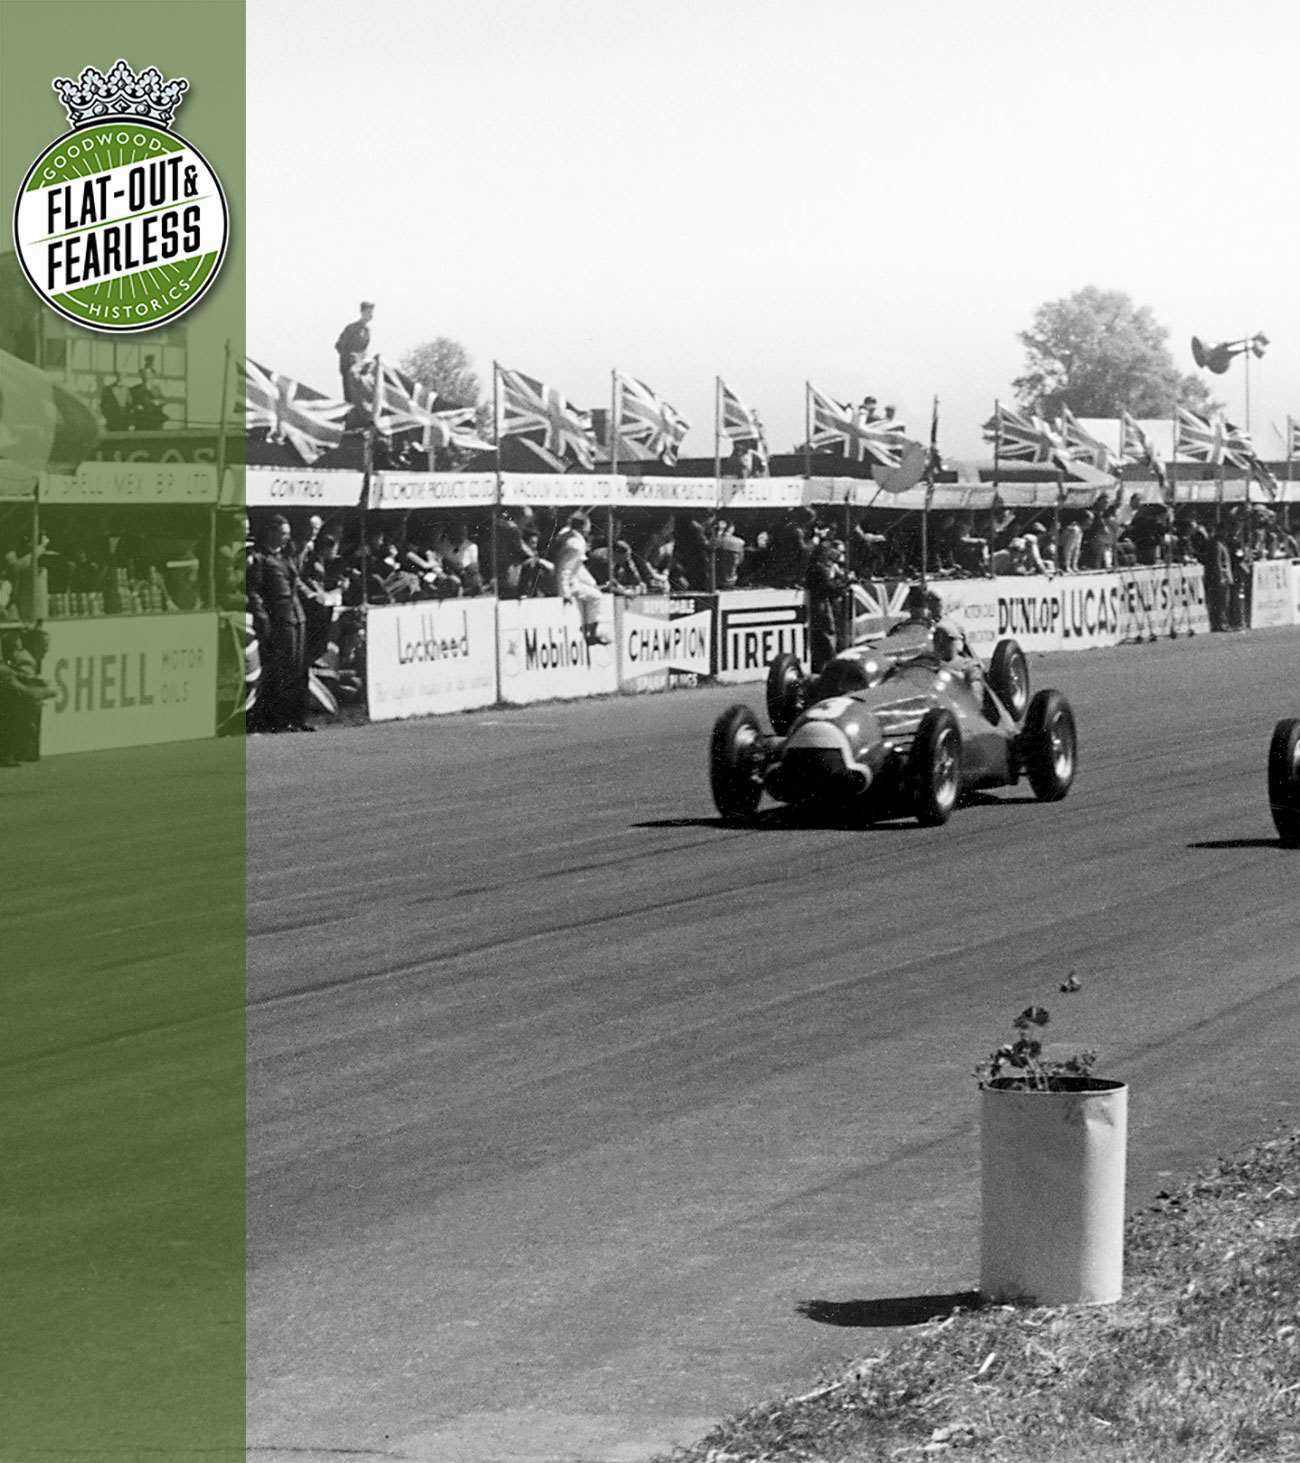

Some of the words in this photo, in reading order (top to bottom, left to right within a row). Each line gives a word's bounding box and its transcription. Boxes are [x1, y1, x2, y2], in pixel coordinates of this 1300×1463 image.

[270, 478, 324, 498] CONTROL
[396, 609, 470, 665] Lockheed
[721, 605, 809, 671] PIRELLI
[998, 597, 1060, 635] DUNLOP
[1061, 587, 1118, 638] LUCAS
[628, 627, 707, 663] CHAMPION
[54, 652, 154, 714] SHELL
